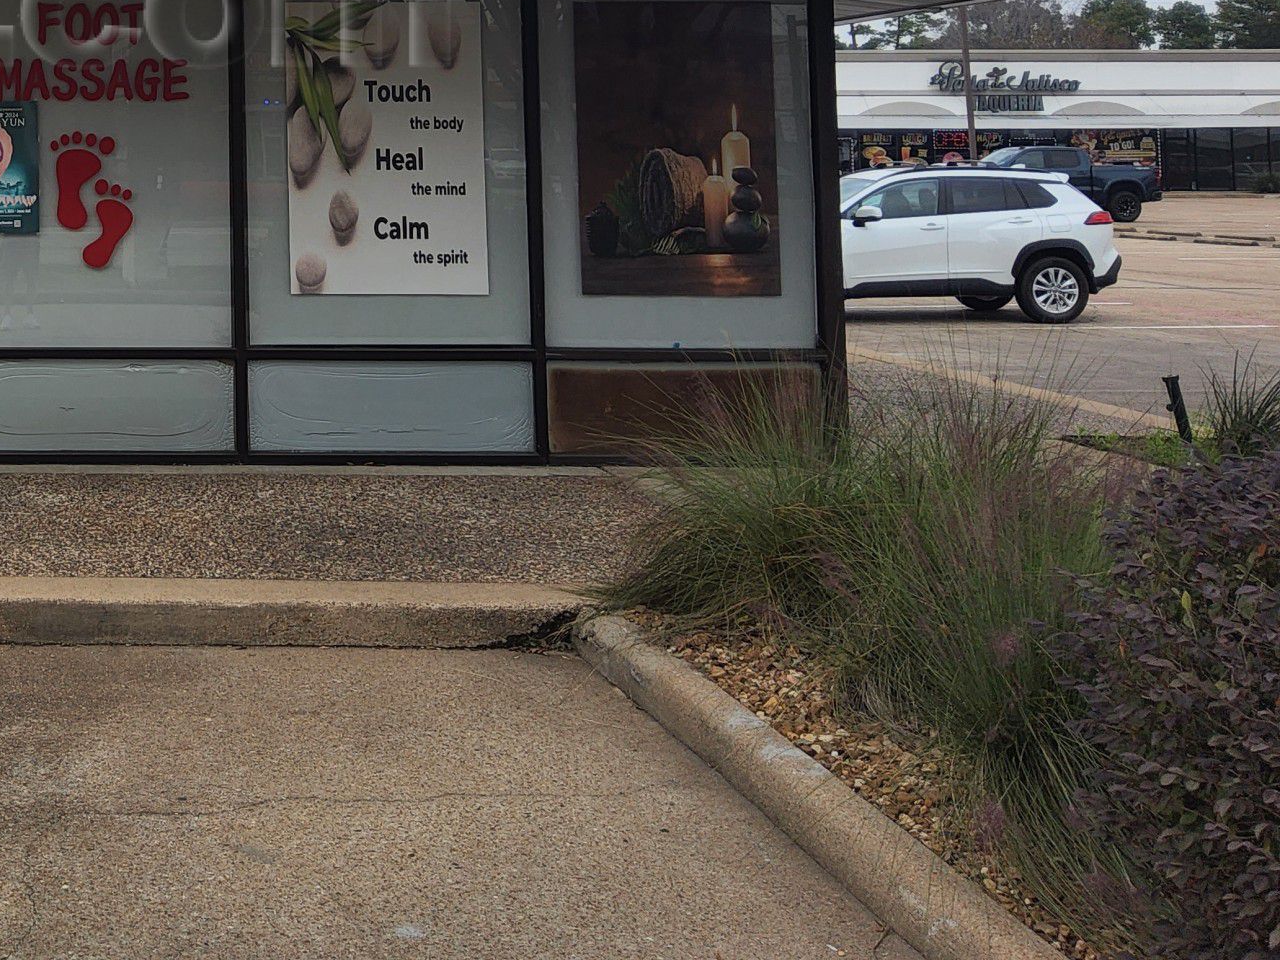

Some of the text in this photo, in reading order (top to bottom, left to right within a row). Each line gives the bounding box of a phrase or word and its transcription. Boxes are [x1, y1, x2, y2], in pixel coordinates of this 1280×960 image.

[37, 2, 144, 46] FOOT
[1006, 71, 1081, 91] Jalisco
[364, 79, 431, 102] Touch
[3, 118, 25, 127] YUN
[410, 117, 464, 132] the body
[1109, 140, 1135, 151] TO GO!
[375, 147, 424, 170] Heal
[411, 181, 466, 195] the mind
[374, 216, 429, 240] Calm
[413, 250, 469, 266] the spirit
